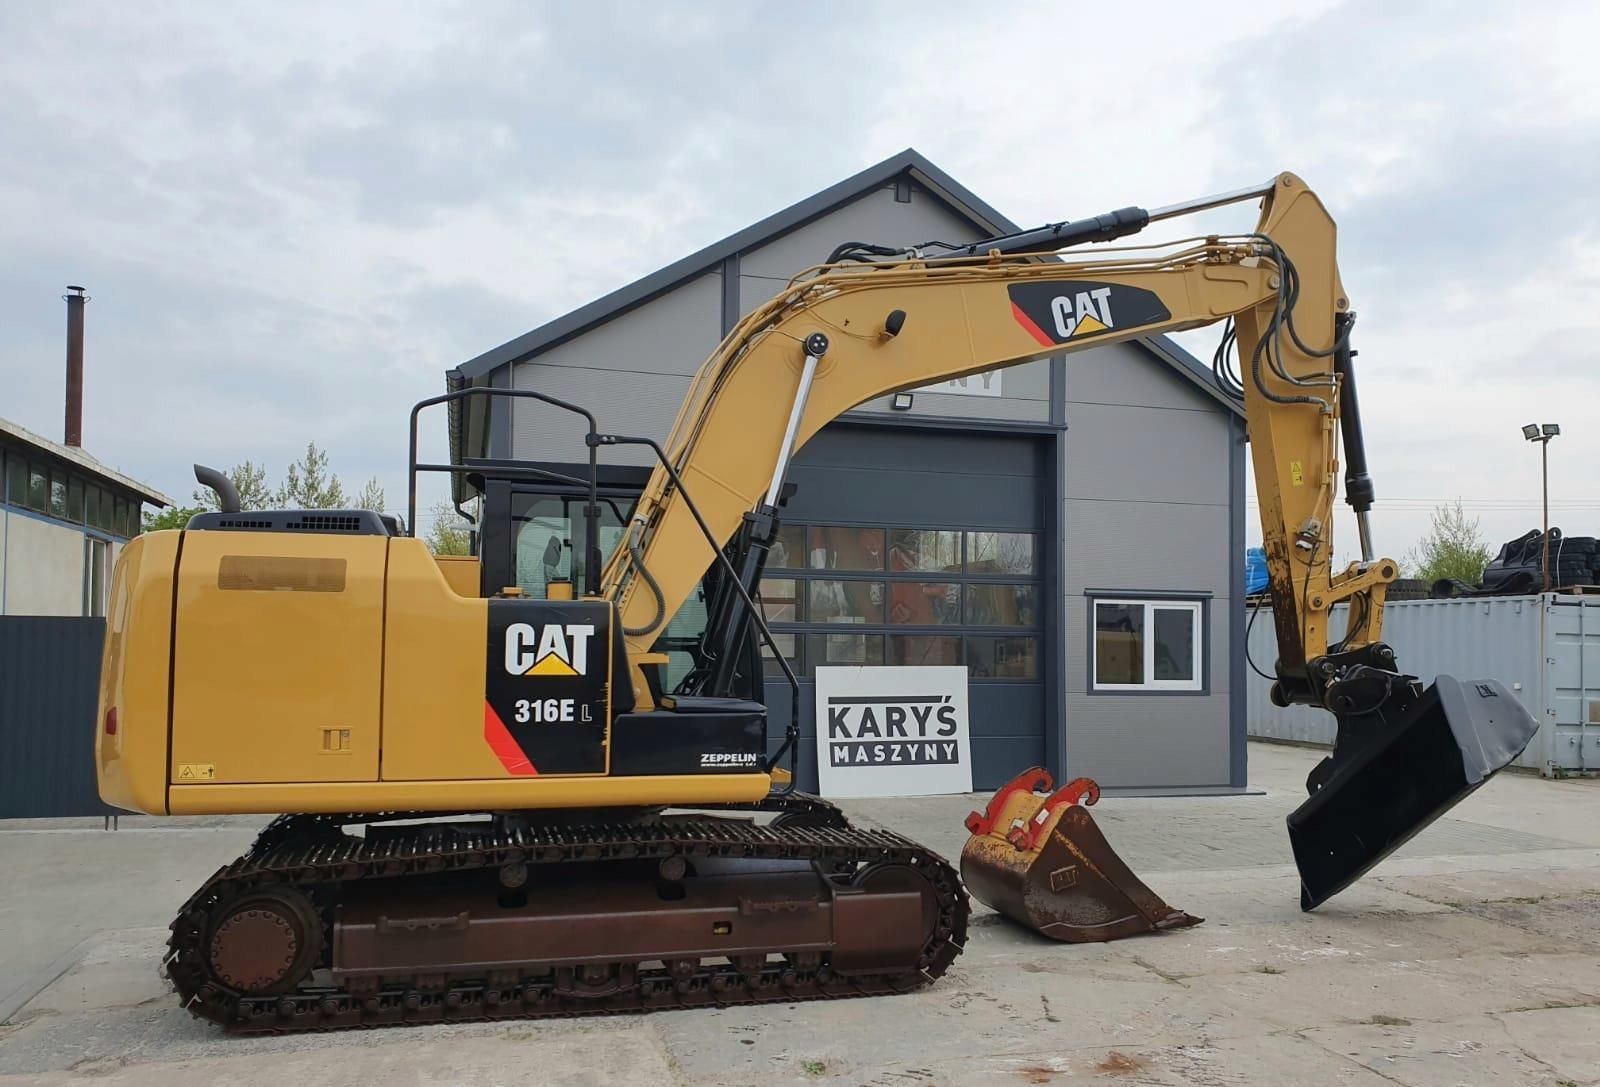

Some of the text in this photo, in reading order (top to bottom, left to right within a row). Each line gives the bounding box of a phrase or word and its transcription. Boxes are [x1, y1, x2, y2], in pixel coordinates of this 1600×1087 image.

[1050, 287, 1114, 338] CAT
[504, 622, 595, 675] CAT
[514, 698, 593, 723] 316E L
[827, 695, 957, 738] KARYŚ
[700, 753, 757, 763] ZEPPELIN
[833, 743, 955, 763] MASZYNY
